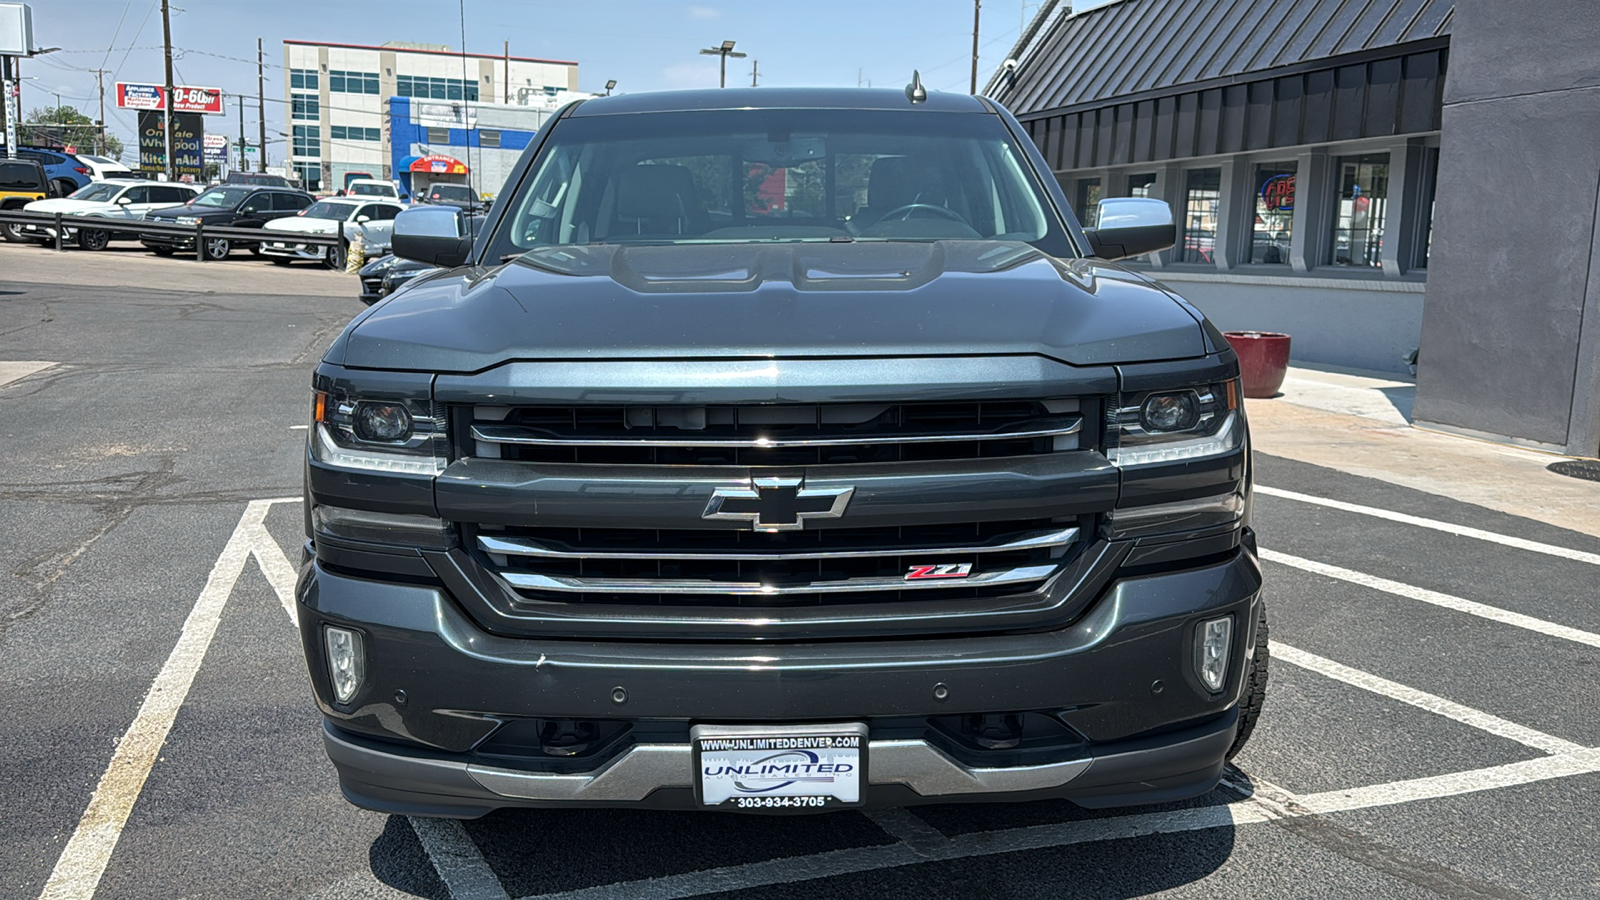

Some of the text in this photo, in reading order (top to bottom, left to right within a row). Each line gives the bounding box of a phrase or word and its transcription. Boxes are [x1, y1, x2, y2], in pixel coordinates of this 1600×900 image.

[174, 88, 204, 103] 0-60
[145, 128, 163, 137] On
[141, 138, 199, 152] Whipool
[141, 152, 200, 166] KitcnAid
[1266, 176, 1296, 210] OPE
[904, 562, 973, 581] Z71
[700, 737, 860, 751] WWWUNLIMITEDDENVER.COM
[704, 763, 854, 776] UNLIMITED
[737, 796, 825, 808] 303-934-3705
